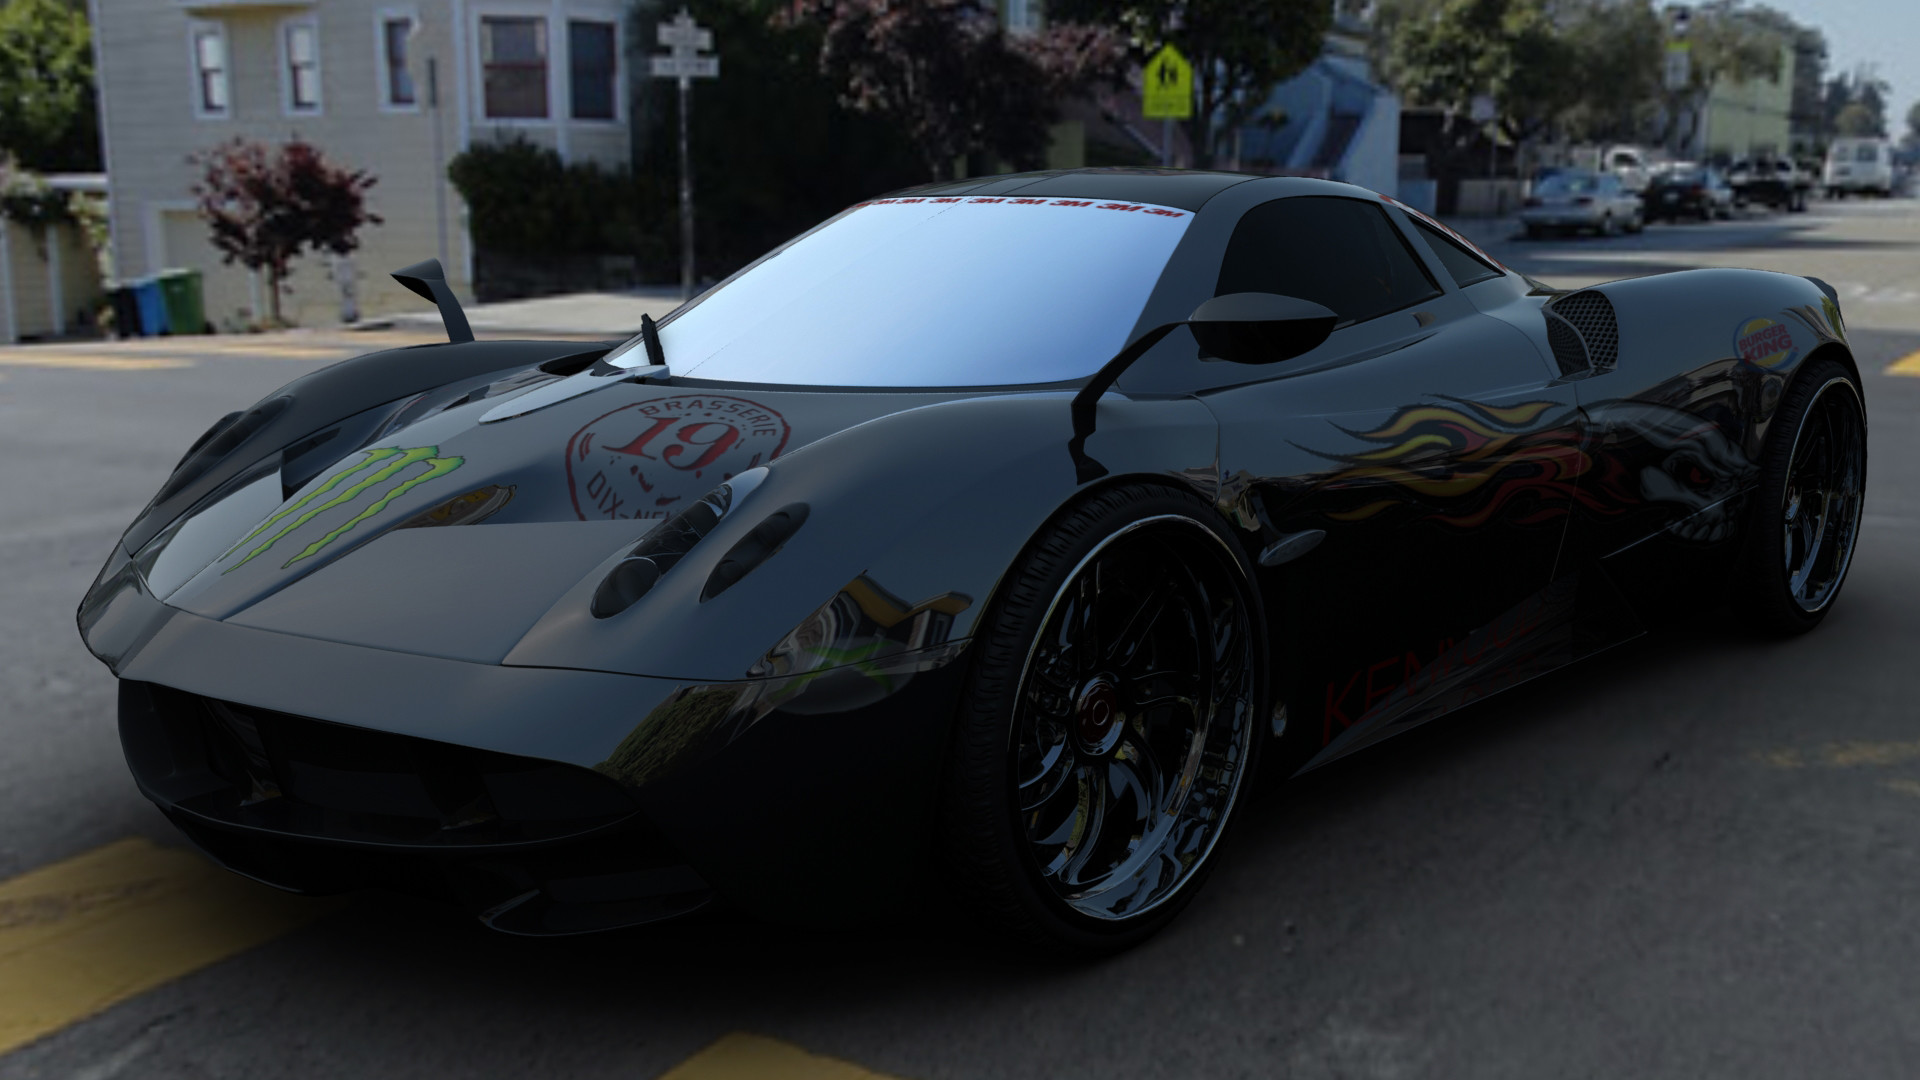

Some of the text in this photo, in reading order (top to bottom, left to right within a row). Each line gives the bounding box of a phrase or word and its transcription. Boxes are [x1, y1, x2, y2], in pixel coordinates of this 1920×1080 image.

[895, 197, 927, 205] 3M
[1049, 199, 1094, 207] 3M
[1096, 203, 1146, 212] 3M
[1143, 208, 1186, 218] 3M
[1738, 324, 1787, 352] BURGER
[1744, 334, 1792, 364] KING
[638, 399, 777, 437] BRASSERIE
[601, 416, 740, 471] 19
[587, 470, 670, 520] DIX-N
